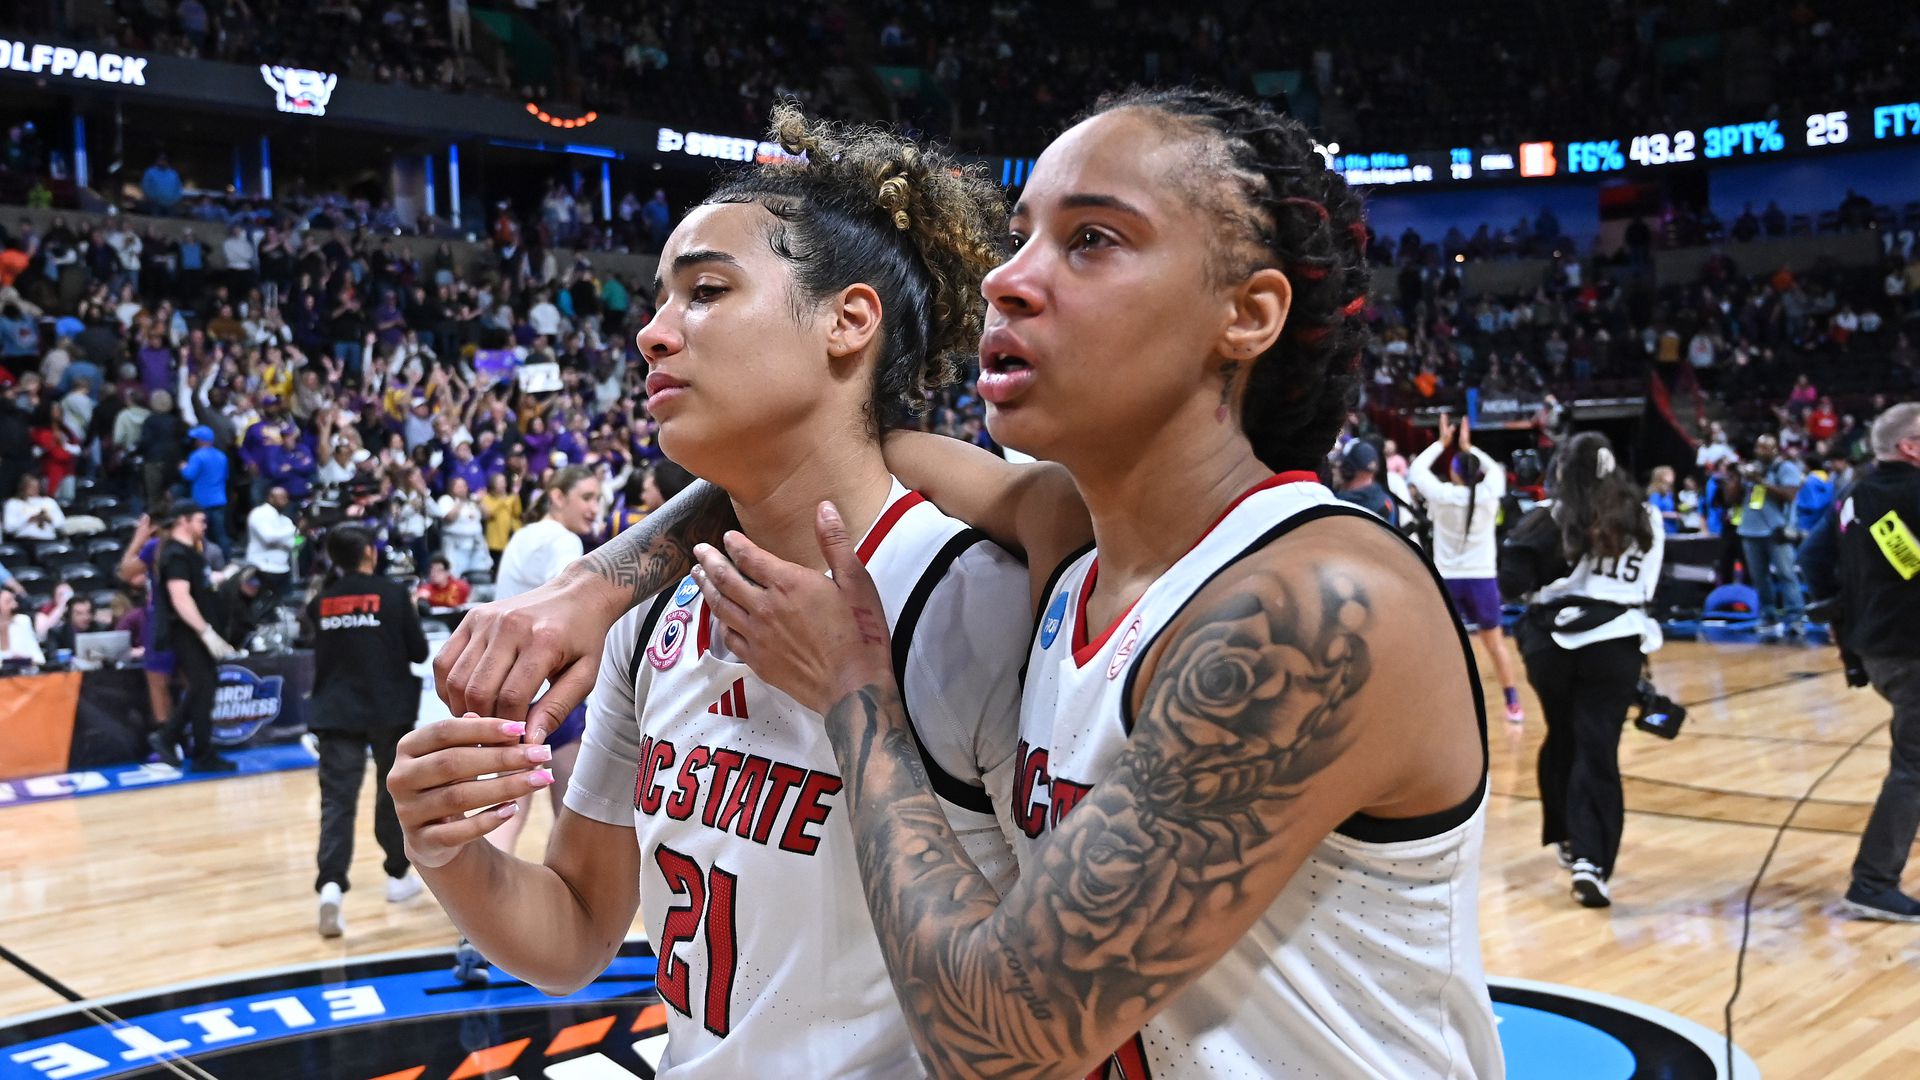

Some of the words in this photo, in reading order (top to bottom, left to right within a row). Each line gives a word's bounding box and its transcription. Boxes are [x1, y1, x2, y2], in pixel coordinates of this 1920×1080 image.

[685, 131, 758, 163] SWEET
[1567, 139, 1625, 174] FG%
[1629, 129, 1695, 166] 43.2
[1703, 119, 1784, 159] 3PT%
[1806, 110, 1848, 147] 25
[320, 613, 381, 631] SOCIAL
[214, 684, 254, 702] ARCH
[666, 745, 844, 856] STATE
[654, 842, 738, 1040] 21
[10, 984, 386, 1080] ELITE
